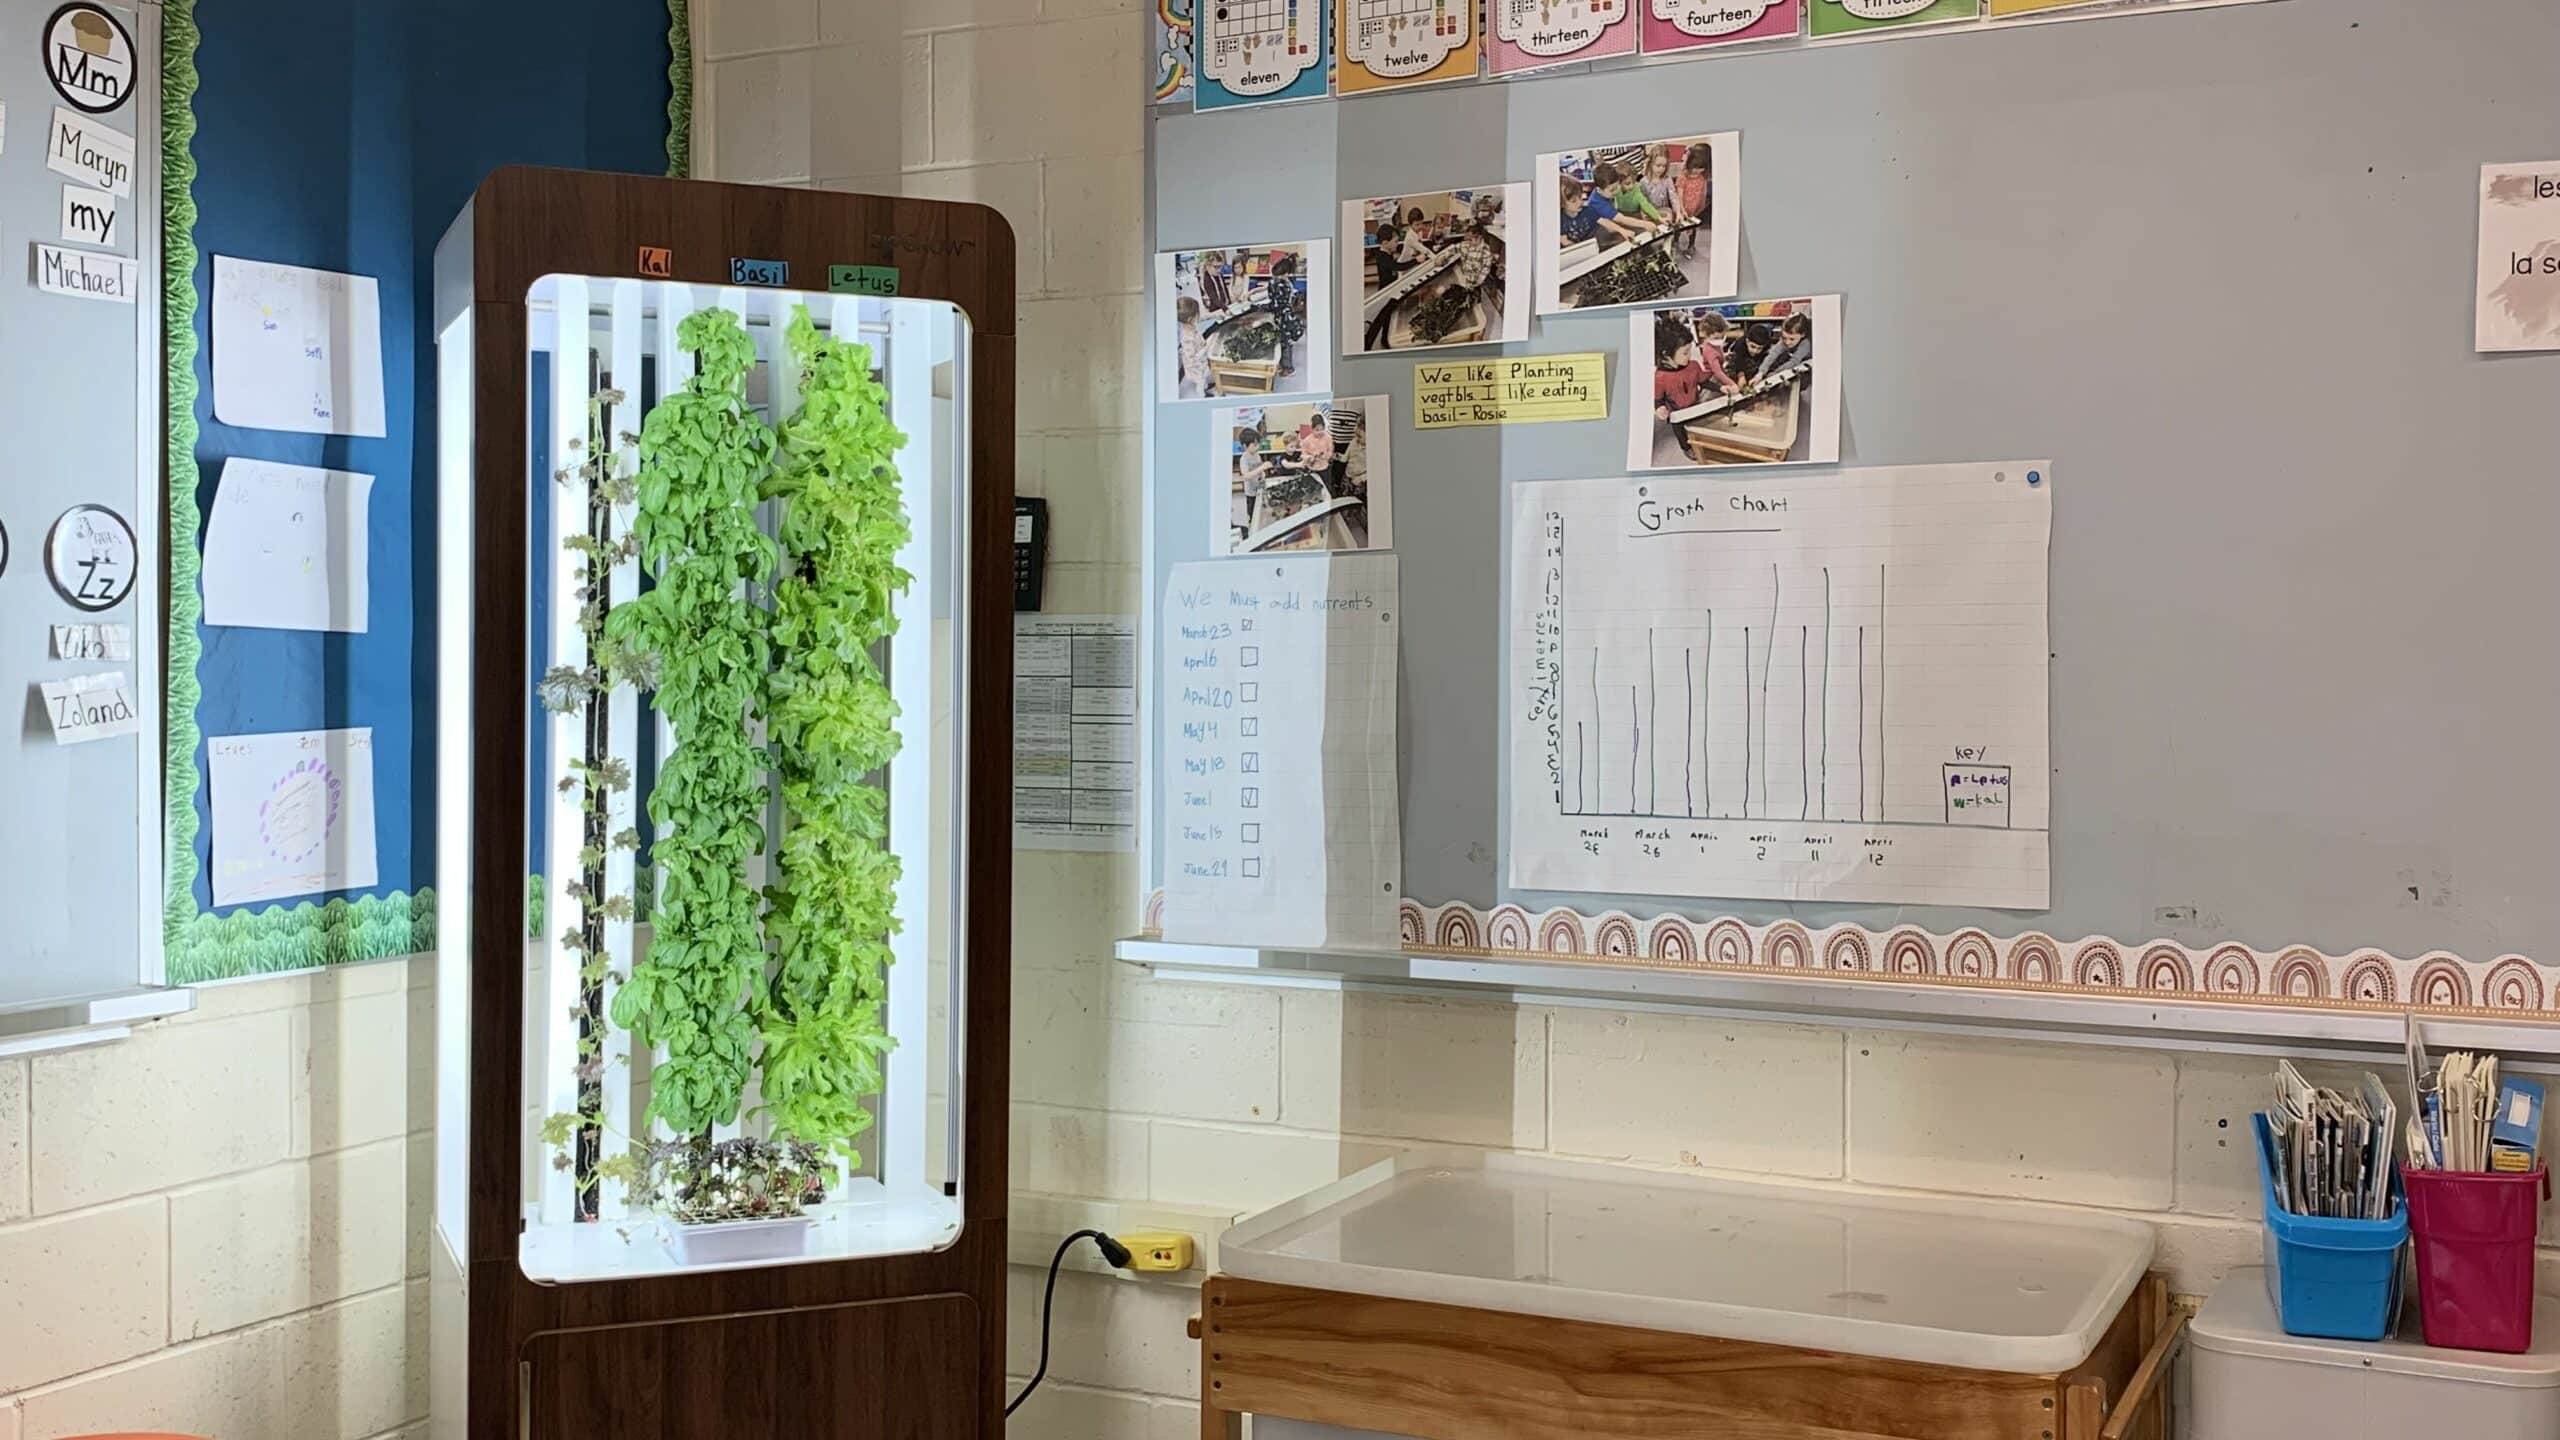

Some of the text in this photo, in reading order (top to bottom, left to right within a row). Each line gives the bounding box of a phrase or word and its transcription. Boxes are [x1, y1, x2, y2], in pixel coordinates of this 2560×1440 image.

[1687, 7, 1753, 26] fourteen
[1530, 27, 1589, 46] thirteen
[1384, 49, 1429, 67] twelve
[57, 44, 120, 99] Mm
[1240, 68, 1280, 86] eleven
[58, 122, 129, 189] Maryn
[69, 200, 115, 243] my
[44, 248, 125, 297] Michael
[642, 248, 670, 274] Kal
[733, 260, 788, 285] Basil
[2511, 252, 2532, 275] la
[830, 267, 896, 293] Letus
[1420, 367, 1452, 383] We
[1511, 361, 1574, 382] Planting
[1421, 386, 1474, 408] vegtbls
[1482, 385, 1496, 401] I
[1542, 381, 1587, 401] eating
[1473, 405, 1507, 421] Rosie
[1638, 498, 1704, 530] Groth
[77, 560, 115, 600] Zz
[1179, 587, 1212, 609] We
[1269, 591, 1300, 610] add
[53, 688, 133, 730] Zoland
